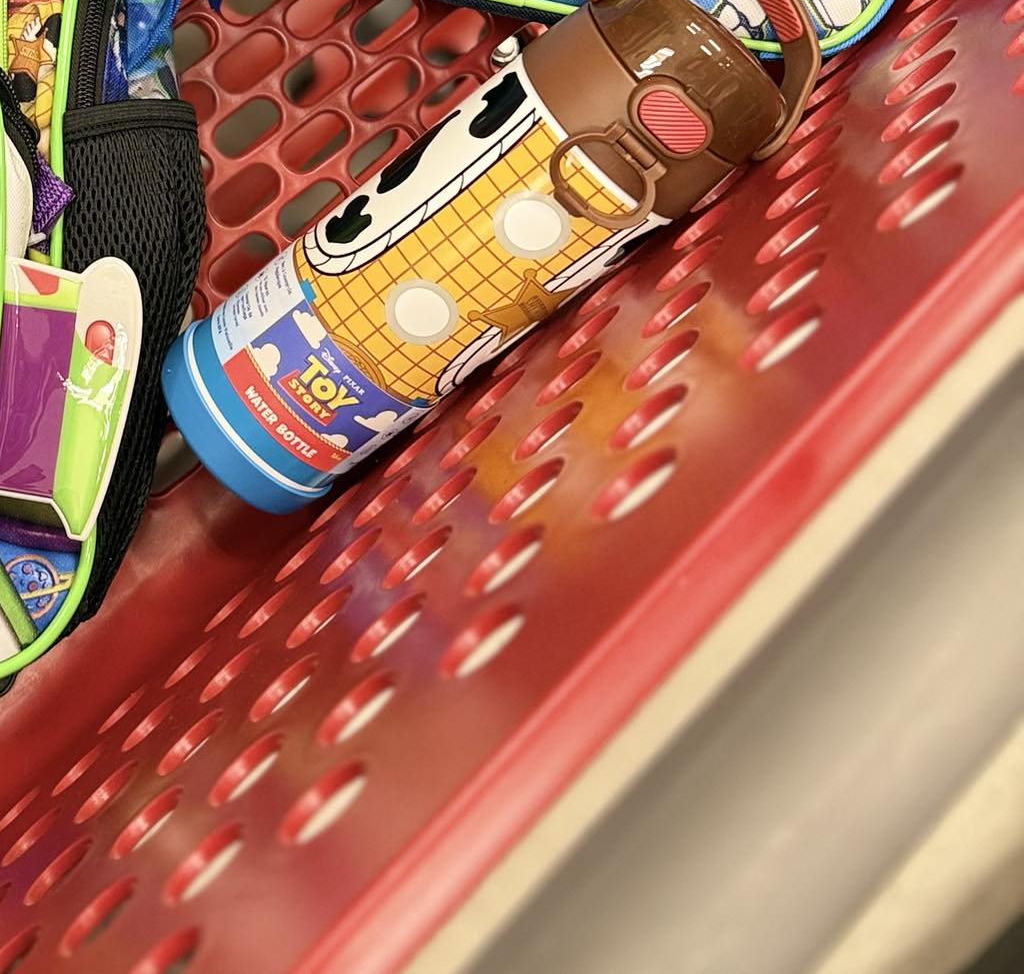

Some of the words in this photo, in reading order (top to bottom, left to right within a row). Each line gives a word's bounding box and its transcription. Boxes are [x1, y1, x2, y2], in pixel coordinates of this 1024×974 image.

[288, 378, 331, 420] STORY
[299, 354, 361, 411] TOY
[342, 375, 365, 396] PIXAR
[245, 386, 278, 425] WATER
[276, 423, 318, 459] BOTTLE
